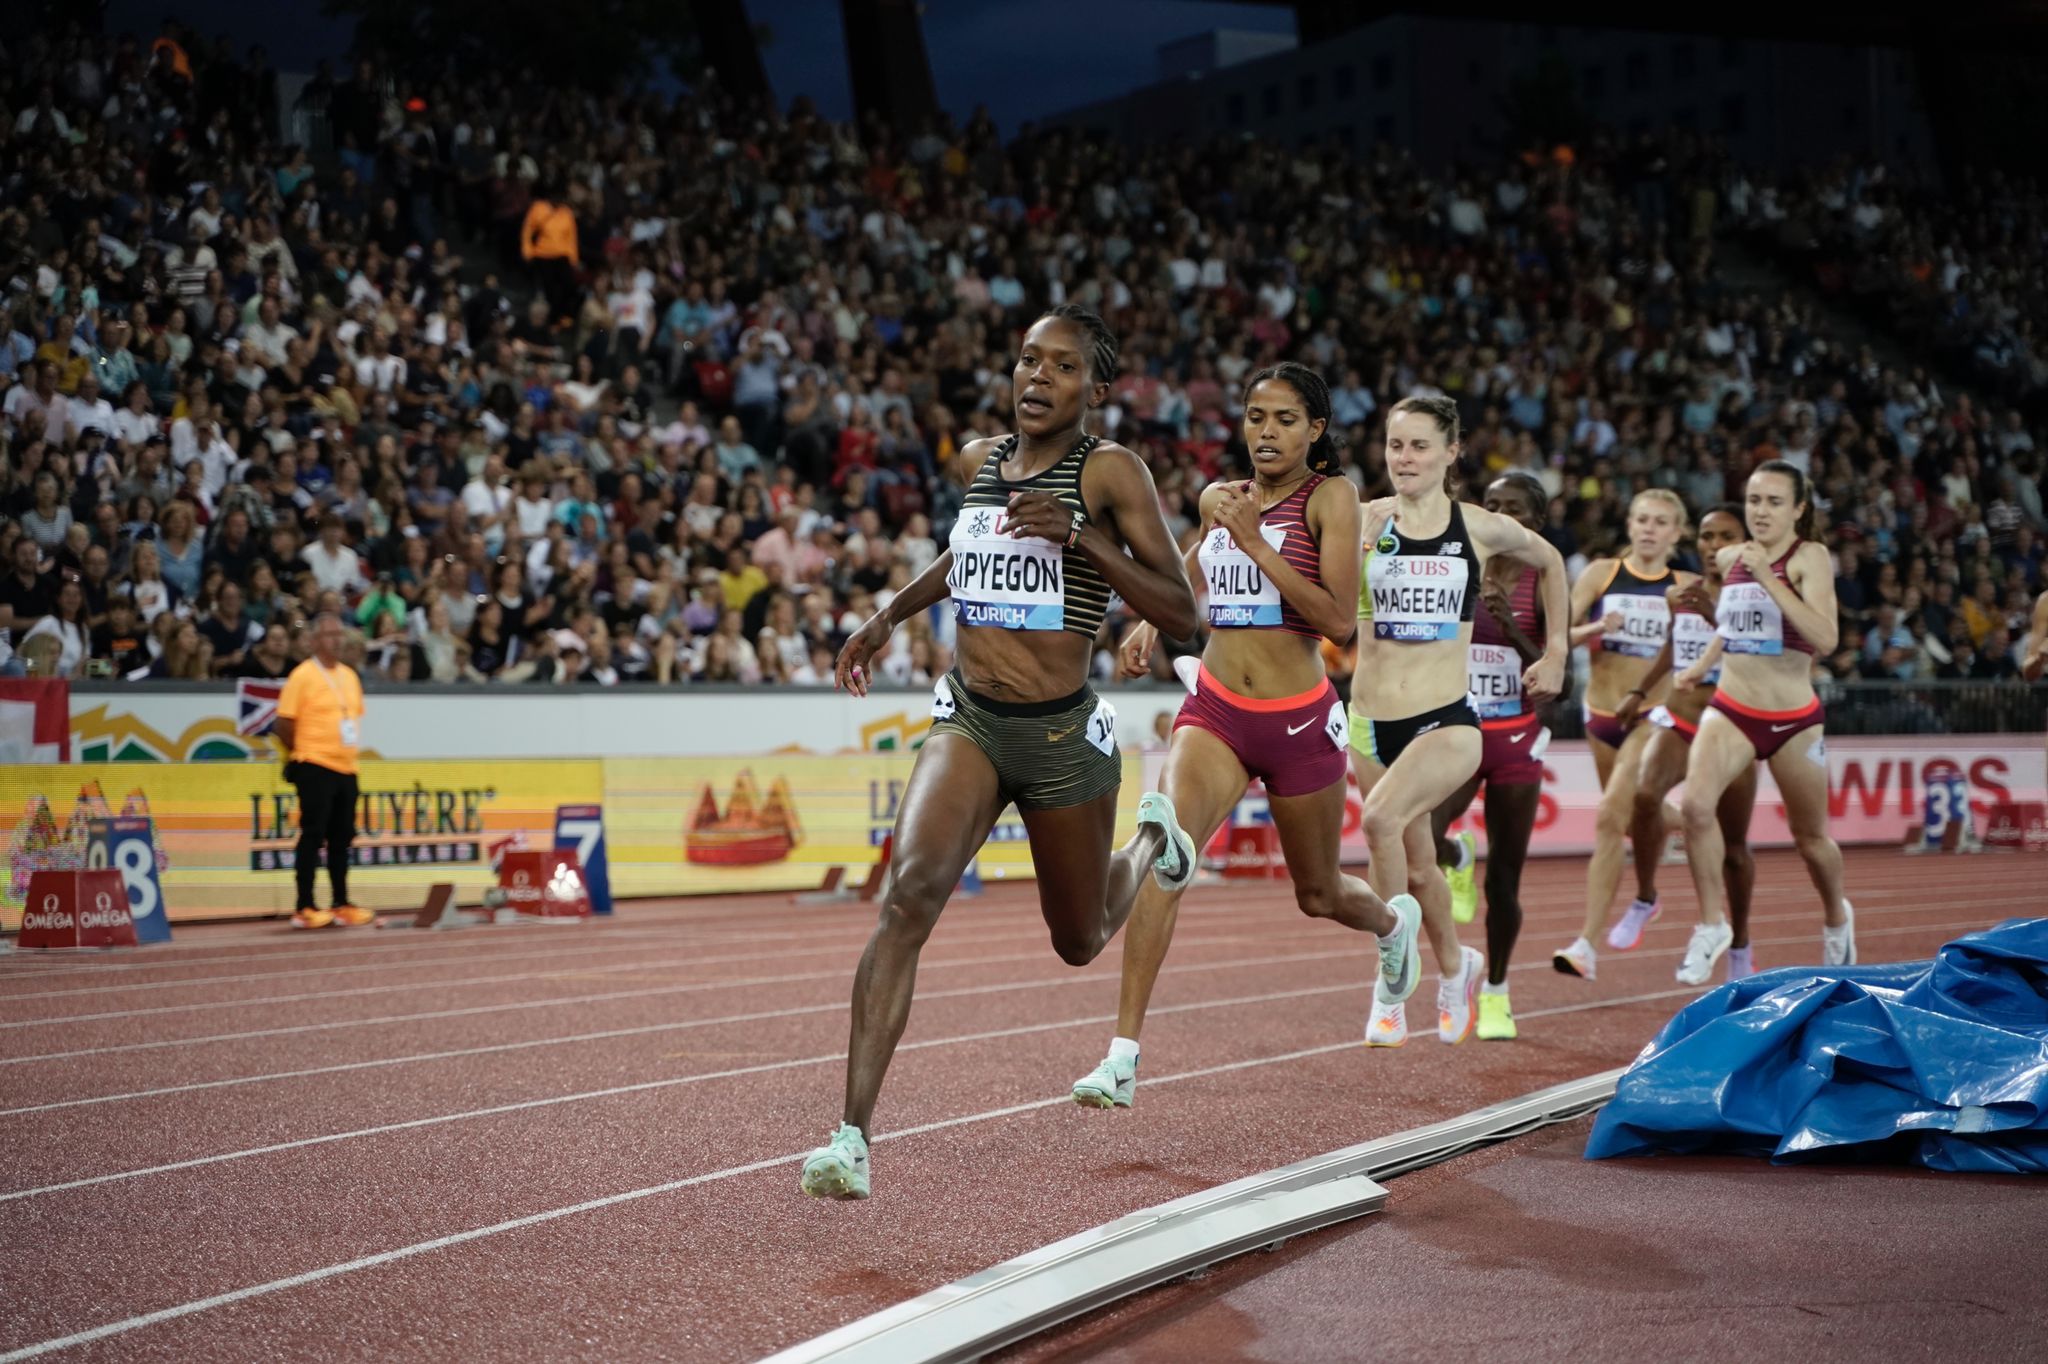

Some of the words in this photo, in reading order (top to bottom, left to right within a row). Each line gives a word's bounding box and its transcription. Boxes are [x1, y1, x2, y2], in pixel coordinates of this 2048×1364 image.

[1410, 560, 1450, 576] UBS
[1374, 587, 1462, 614] MAGEEAN
[966, 604, 1026, 624] ZURICH
[1392, 624, 1439, 636] ZURICH
[1472, 649, 1505, 664] UBS
[1469, 673, 1517, 696] LTEJI
[1928, 781, 1949, 837] 3
[557, 820, 601, 869] 7
[114, 838, 157, 919] 8
[24, 912, 74, 930] OMEGA
[80, 909, 131, 928] OMEGA
